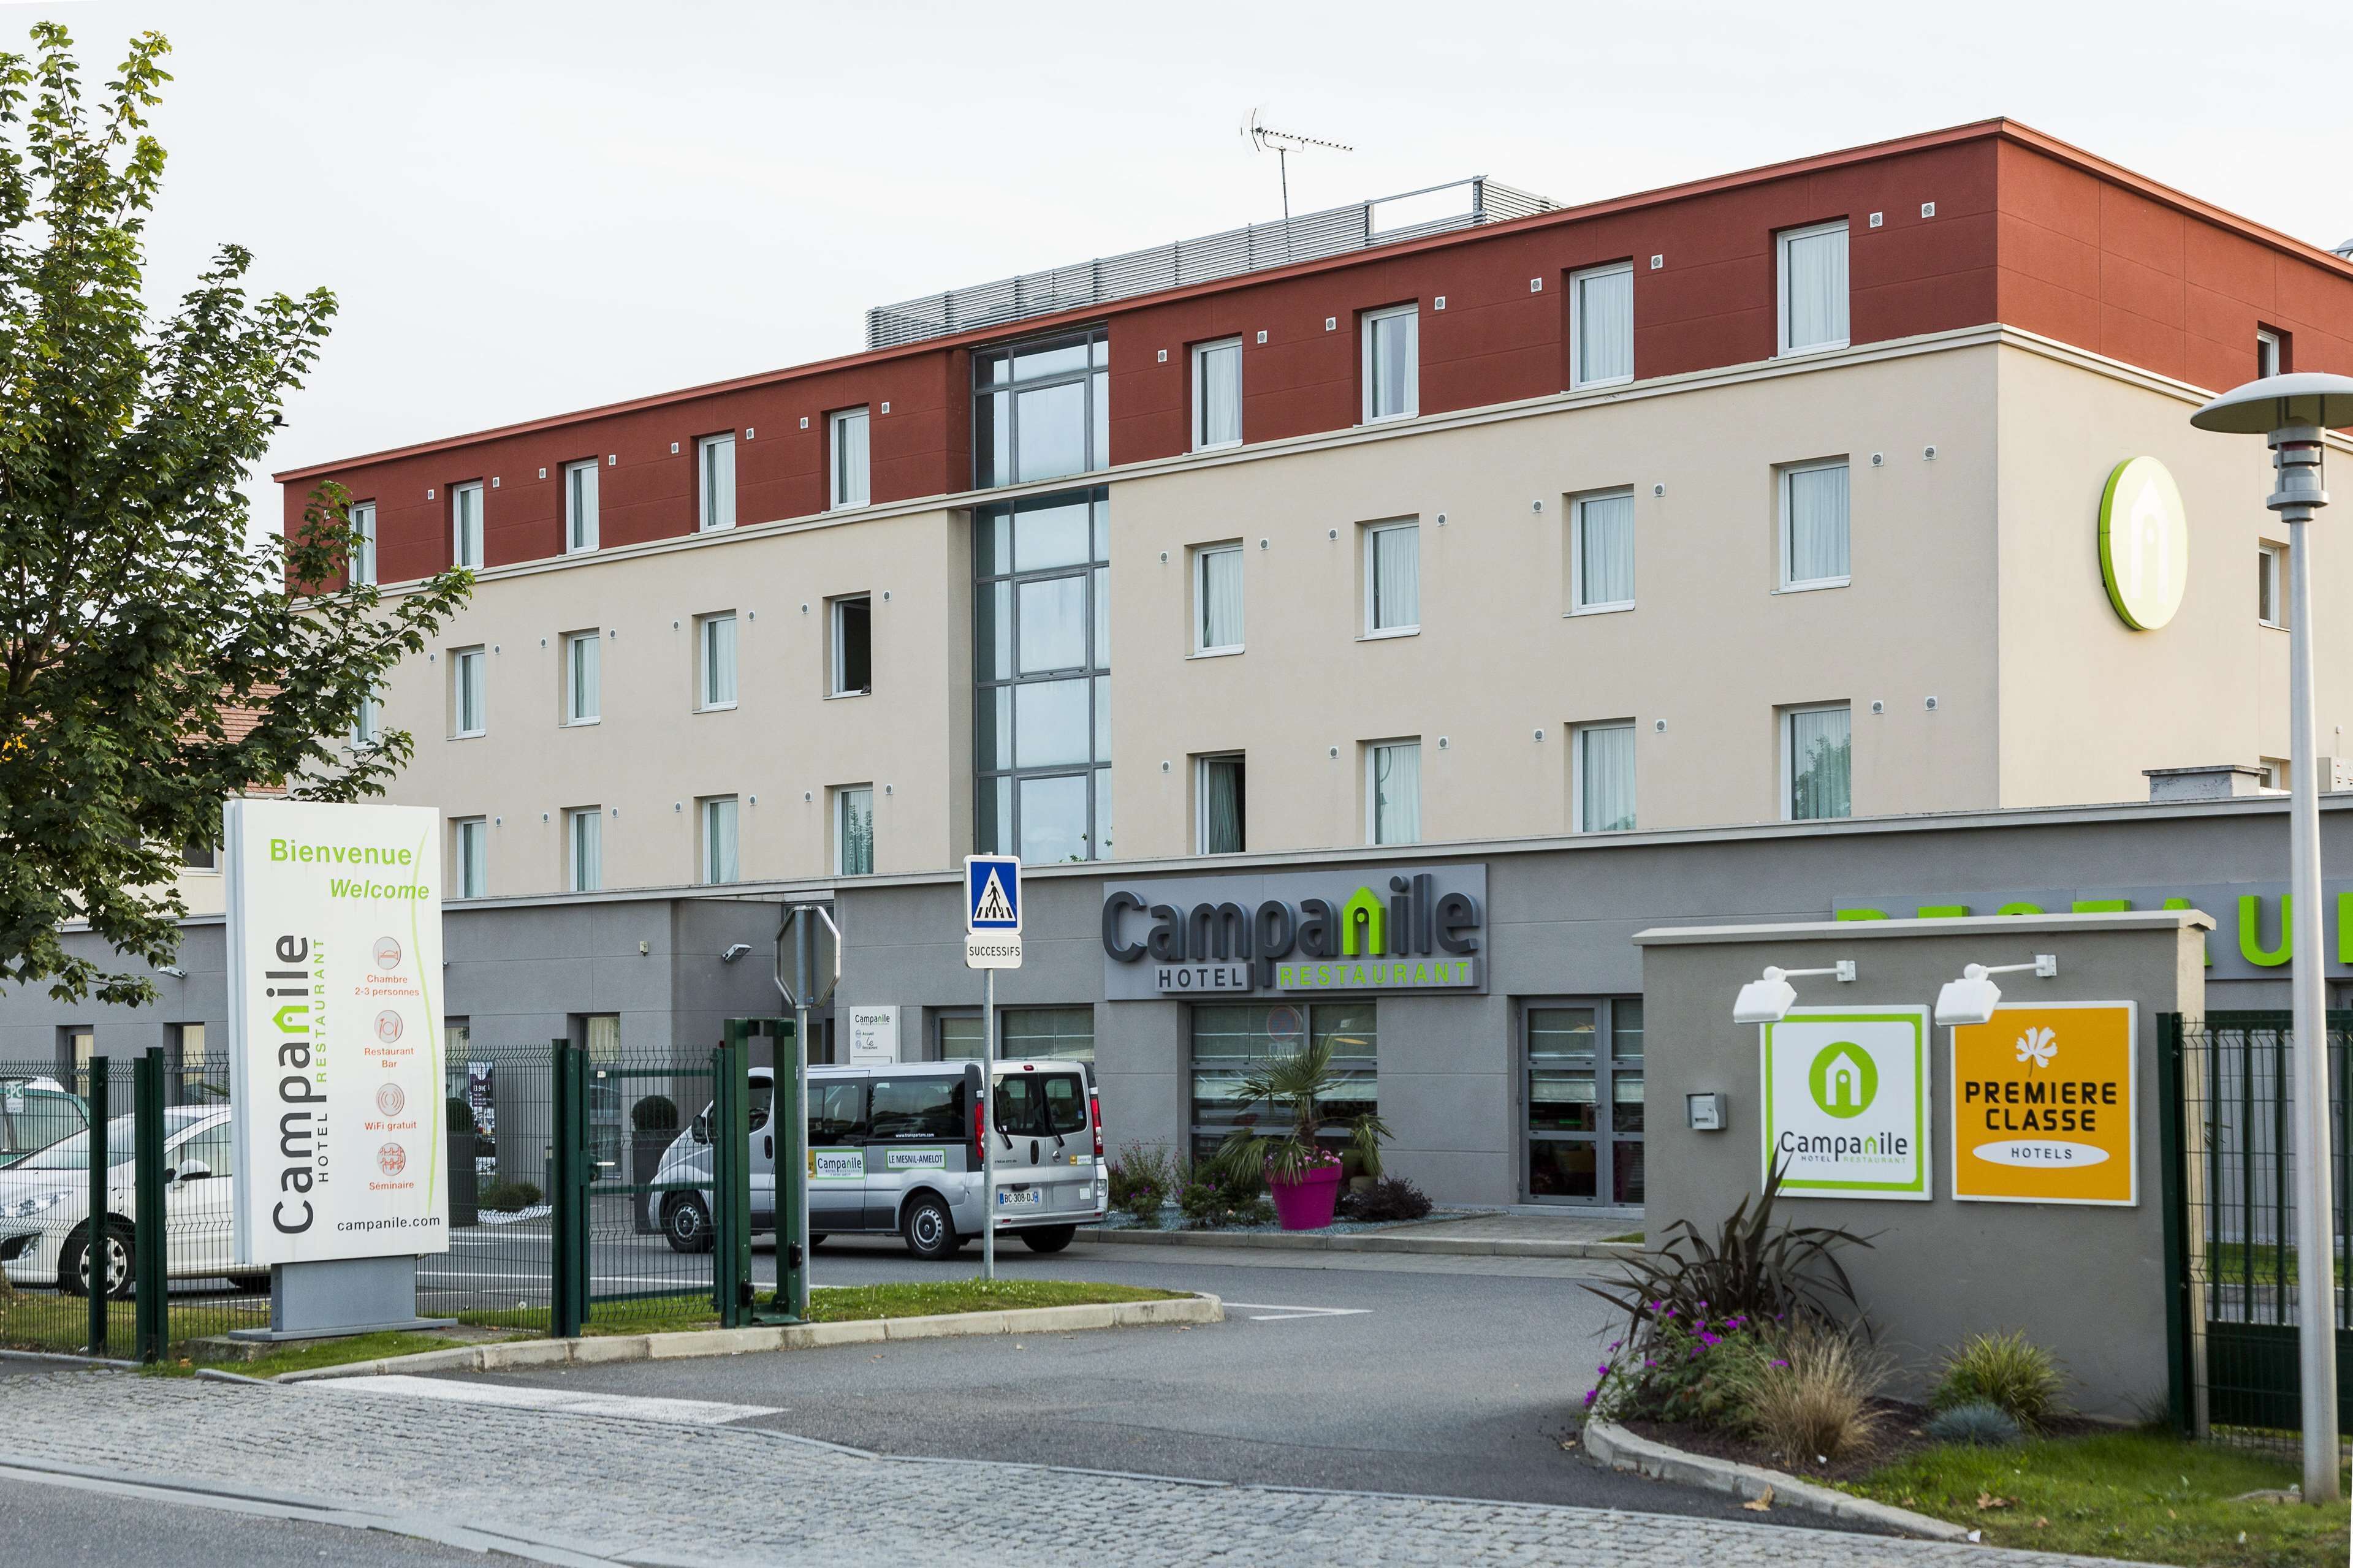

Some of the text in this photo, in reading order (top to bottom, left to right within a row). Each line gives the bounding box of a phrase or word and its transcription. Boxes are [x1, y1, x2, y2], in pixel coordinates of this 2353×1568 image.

[270, 838, 412, 865] Bienvenue
[330, 879, 430, 900] Welcome
[1102, 873, 1480, 987] Campanile
[969, 946, 1020, 956] SUCCESSIFS
[367, 974, 408, 983] Chambre
[1158, 967, 1243, 988] HOTEL
[1280, 961, 1470, 987] RESTAURANT
[373, 988, 419, 997] personnes
[314, 939, 327, 1083] RESTAURANT
[855, 1013, 891, 1026] Campanile
[364, 1047, 414, 1056] Restaurant
[265, 935, 327, 1234] Campanile
[1965, 1081, 2116, 1105] PREMIERE
[387, 1121, 417, 1131] gratuit
[1986, 1108, 2096, 1131] CLASSE
[317, 1114, 329, 1183] HOTEL
[1781, 1131, 1907, 1162] Campanile
[2012, 1148, 2072, 1159] HOTELS
[818, 1157, 862, 1172] Campanile
[896, 1154, 943, 1164] MESNIL-AMELOT
[369, 1180, 414, 1191] Séminaire
[338, 1217, 440, 1232] campanile.com
